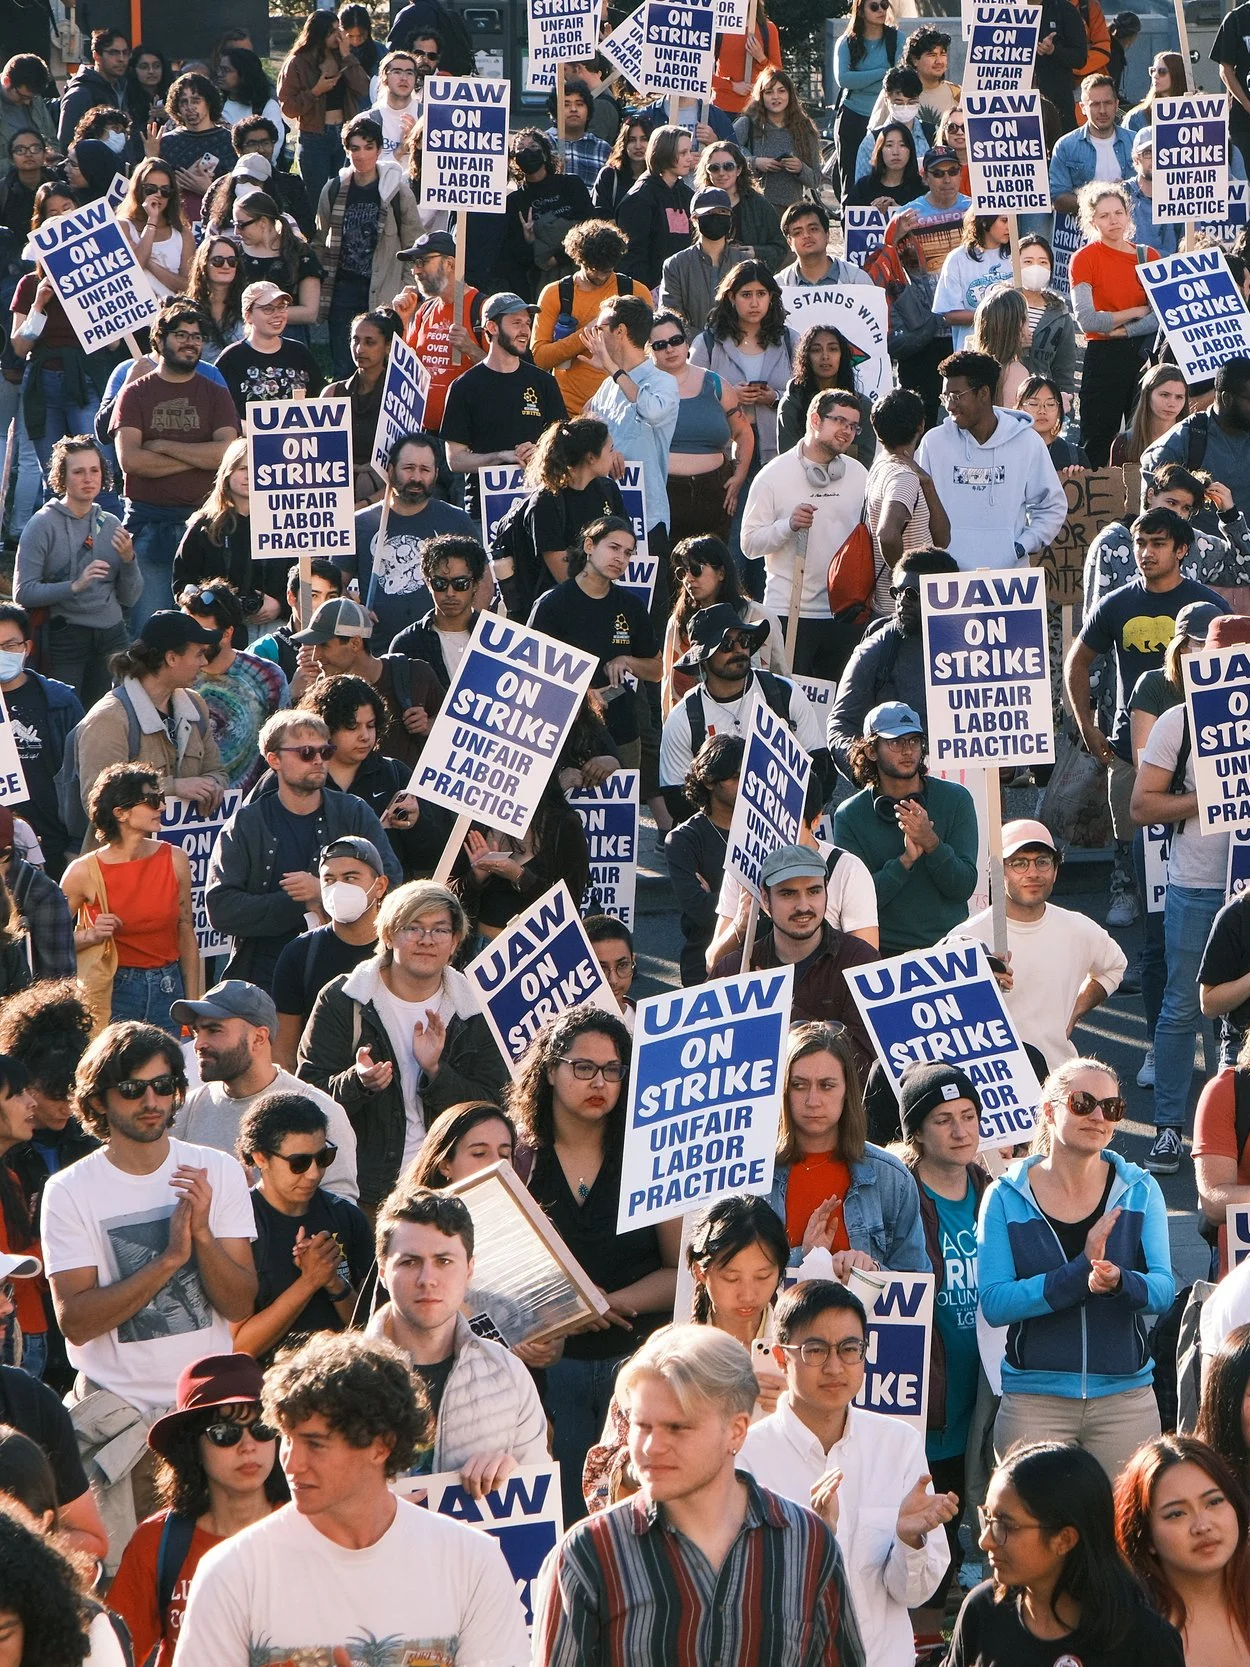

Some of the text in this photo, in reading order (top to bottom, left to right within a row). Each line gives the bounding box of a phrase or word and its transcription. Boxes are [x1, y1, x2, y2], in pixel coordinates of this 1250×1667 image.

[429, 81, 506, 103] UAW
[966, 94, 1036, 115] UAW
[451, 109, 481, 128] ON
[1157, 99, 1225, 121] UAW
[429, 129, 502, 151] STRIKE
[990, 120, 1018, 138] ON
[1178, 125, 1203, 144] ON
[973, 139, 1040, 158] STRIKE
[1158, 144, 1223, 166] STRIKE
[437, 155, 493, 172] UNFAIR
[982, 163, 1035, 178] UNFAIR
[439, 172, 490, 188] LABOR
[986, 179, 1034, 193] LABOR
[1166, 169, 1216, 185] UNFAIR
[426, 188, 502, 206] PRACTICE
[977, 193, 1047, 208] PRACTICE
[1169, 185, 1214, 201] LABOR
[1158, 199, 1225, 217] PRACTICE
[34, 202, 107, 251] UAW
[69, 237, 100, 264] ON
[59, 247, 131, 293] STRIKE
[1141, 251, 1219, 283] UAW
[76, 274, 133, 309] UNFAIR
[1178, 279, 1211, 301] ON
[86, 290, 138, 324] LABOR
[793, 292, 884, 344] STANDS WITH
[1165, 294, 1241, 325] STRIKE
[83, 299, 157, 344] PRACTICE
[1182, 318, 1242, 343] UNFAIR
[426, 332, 450, 341] PEOPL
[427, 343, 449, 353] OVER
[1191, 333, 1246, 357] LABOR
[422, 354, 450, 365] PROFIT
[253, 404, 346, 430] UAW
[282, 436, 318, 459] ON
[257, 461, 346, 486] STRIKE
[268, 492, 337, 511] UNFAIR
[272, 511, 334, 530] LABOR
[258, 530, 350, 550] PRACTICE
[927, 576, 1039, 610] UAW
[964, 616, 1006, 646] ON
[479, 619, 591, 685] UAW
[934, 647, 1041, 679] STRIKE
[496, 671, 542, 708] ON
[948, 685, 1031, 710] UNFAIR
[453, 688, 559, 750] STRIKE
[954, 710, 1029, 734] LABOR
[451, 726, 533, 776] UNFAIR
[937, 733, 1048, 759] PRACTICE
[445, 750, 520, 797] LABOR
[418, 766, 528, 826] PRACTICE
[643, 970, 785, 1036] UAW
[680, 1028, 734, 1070] ON
[637, 1057, 772, 1116] STRIKE
[649, 1105, 752, 1150] UNFAIR
[650, 1135, 744, 1178] LABOR
[627, 1158, 765, 1210] PRACTICE
